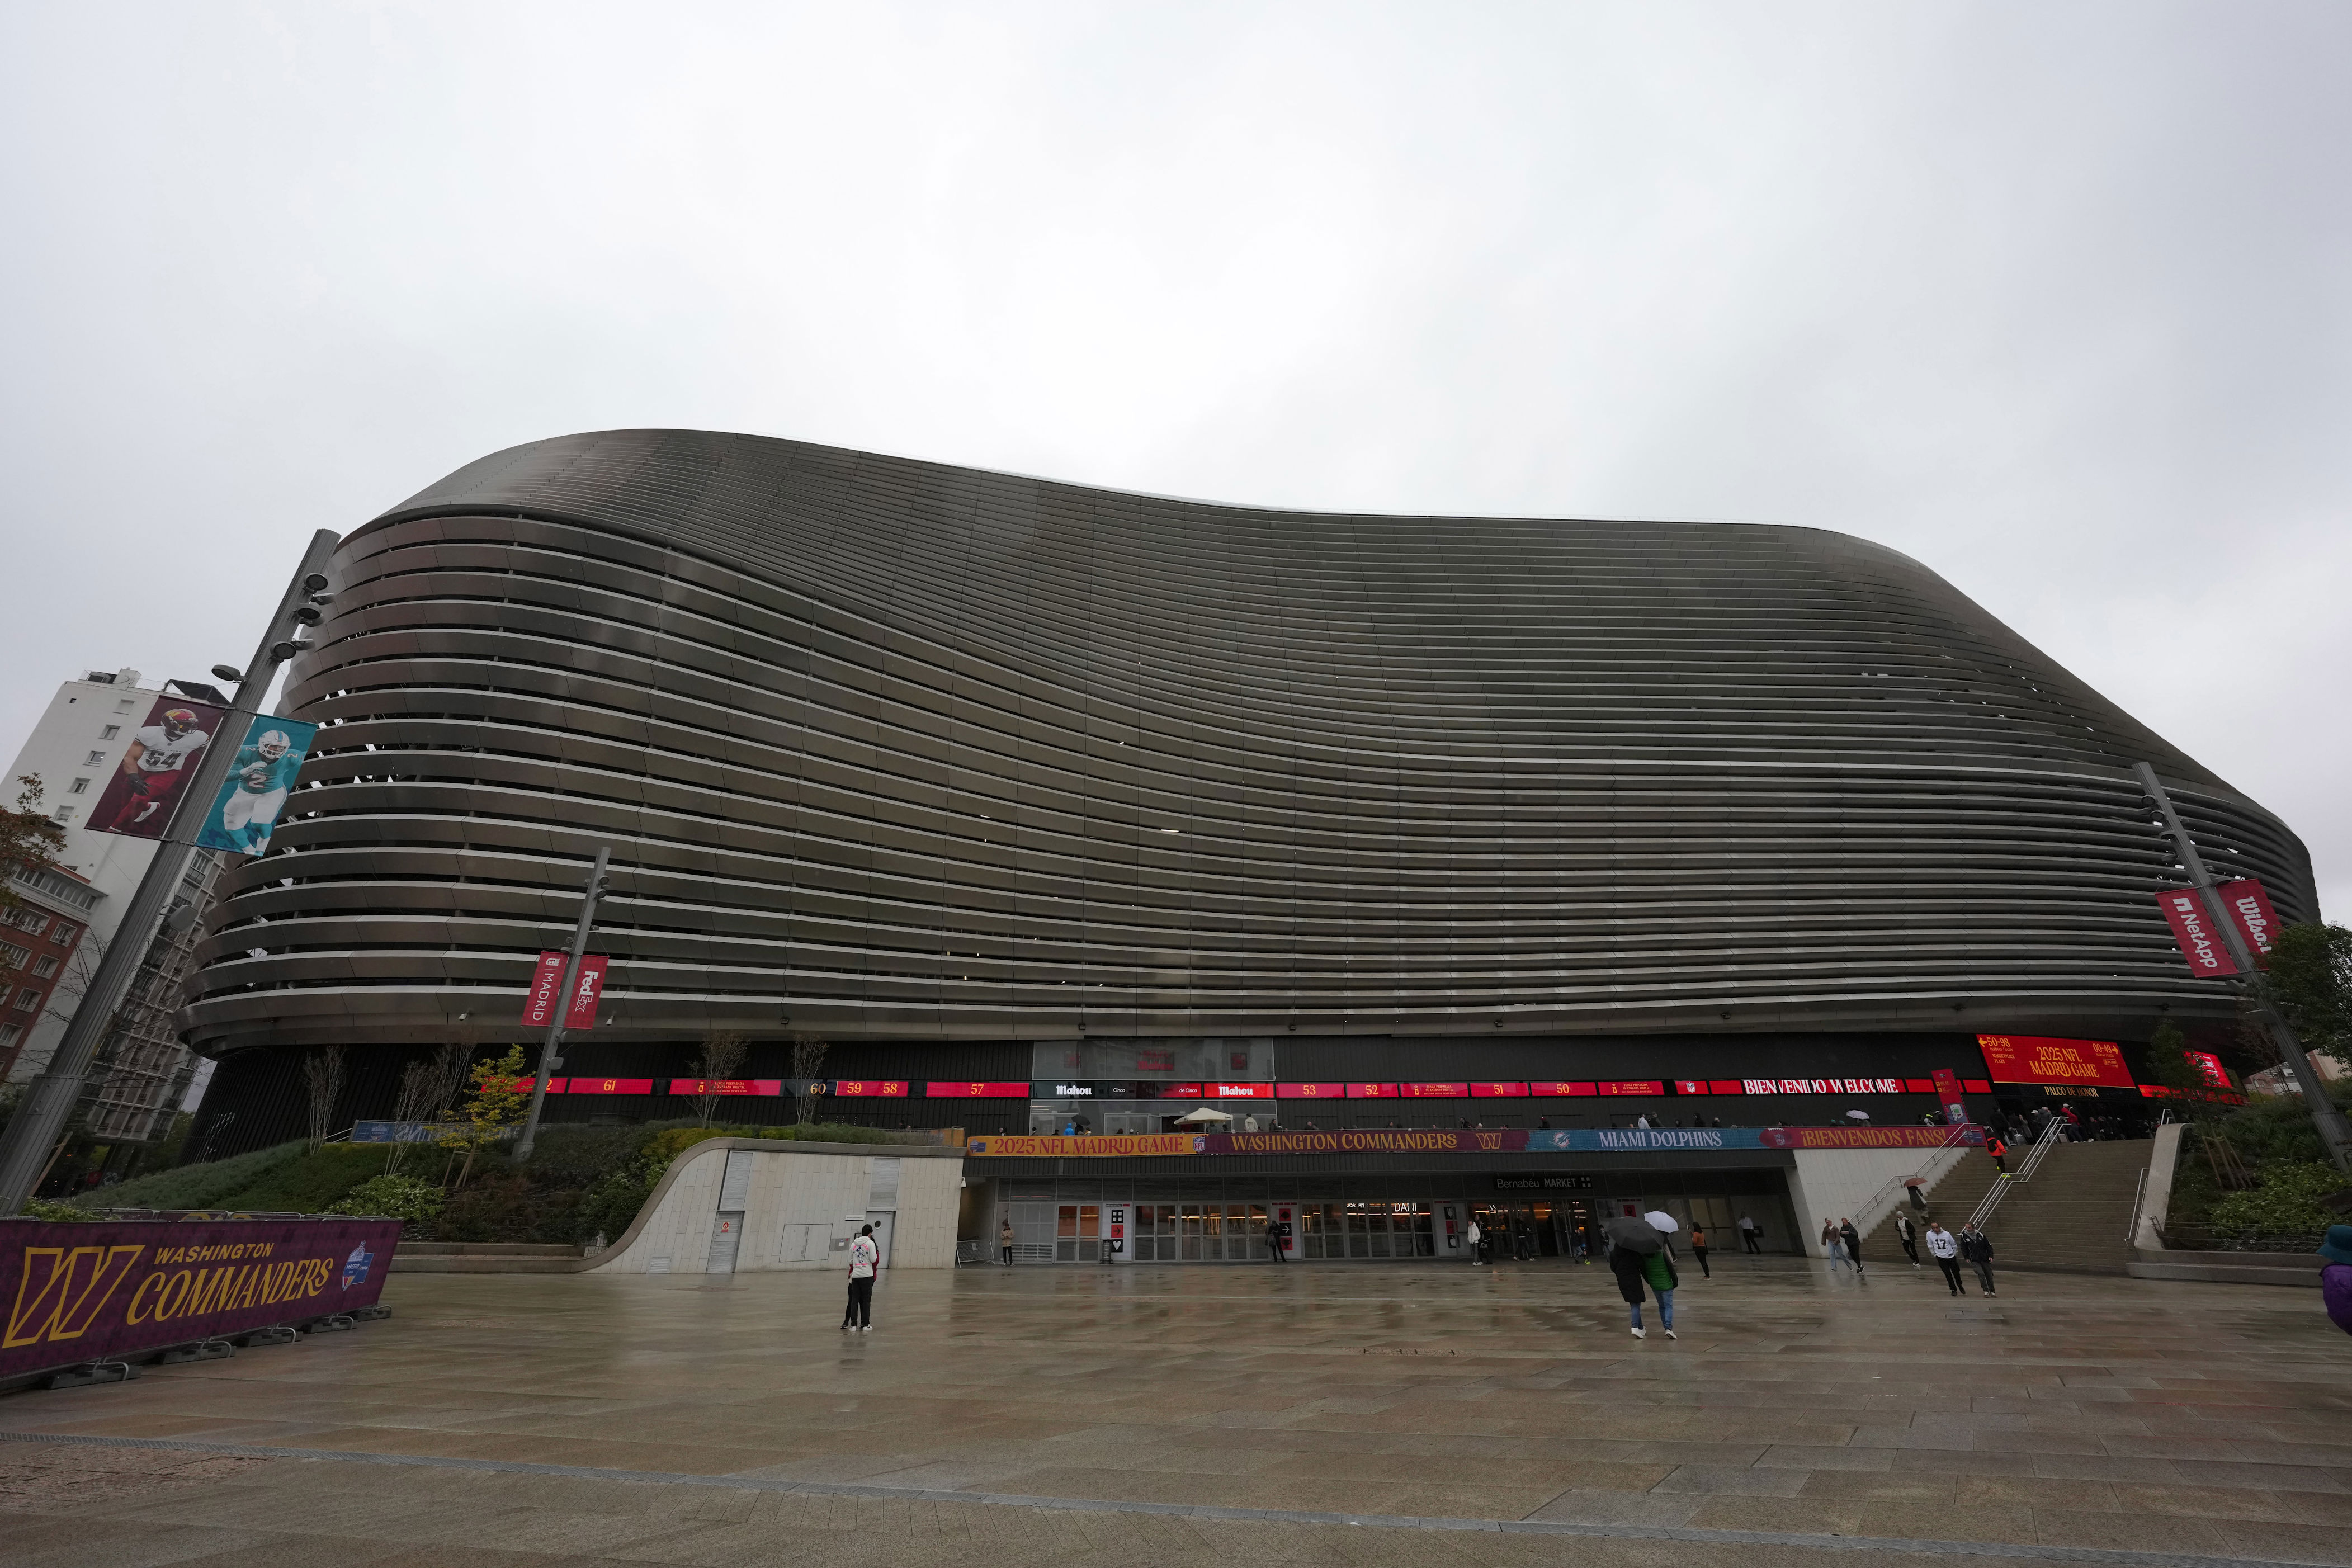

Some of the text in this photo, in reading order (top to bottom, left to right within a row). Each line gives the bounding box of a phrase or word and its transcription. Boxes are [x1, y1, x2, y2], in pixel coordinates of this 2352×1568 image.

[145, 750, 182, 769] 54
[248, 774, 267, 788] 2
[2236, 896, 2272, 952] Wilson
[2181, 914, 2218, 968] NetApp
[532, 972, 555, 1021] MADRID
[574, 971, 599, 1012] FedEx
[1986, 1037, 2010, 1047] 50-98
[2036, 1046, 2083, 1062] 2025 NFL
[2092, 1043, 2112, 1054] 00-49
[2029, 1061, 2071, 1078] MADRID
[2070, 1062, 2100, 1078] GAME
[603, 1080, 616, 1092] 61
[810, 1083, 826, 1094] 60
[847, 1083, 862, 1094] 59
[883, 1083, 898, 1094] 58
[970, 1084, 985, 1094] 57
[1056, 1085, 1092, 1095] Mahou
[1219, 1086, 1254, 1095] Mahou
[1303, 1085, 1316, 1095] 53
[1366, 1085, 1378, 1095] 52
[1494, 1084, 1504, 1094] 51
[1556, 1084, 1570, 1094] 50
[1833, 1079, 1898, 1094] WELCOME
[2044, 1085, 2099, 1097] PALCO DE HONOR
[1231, 1133, 1457, 1151] WASHINGTON COMMANDERS
[1599, 1131, 1722, 1147] MIAMI DOLPHINS
[1801, 1128, 1947, 1146] ¡BIENVENIDOS FANS!
[994, 1136, 1184, 1154] 2025 NFL MADRID GAME
[1497, 1178, 1576, 1188] Bernabéu MARKET
[1935, 1239, 1946, 1249] 17
[154, 1243, 274, 1264] WASHINGTON
[126, 1258, 334, 1325] COMMANDERS
